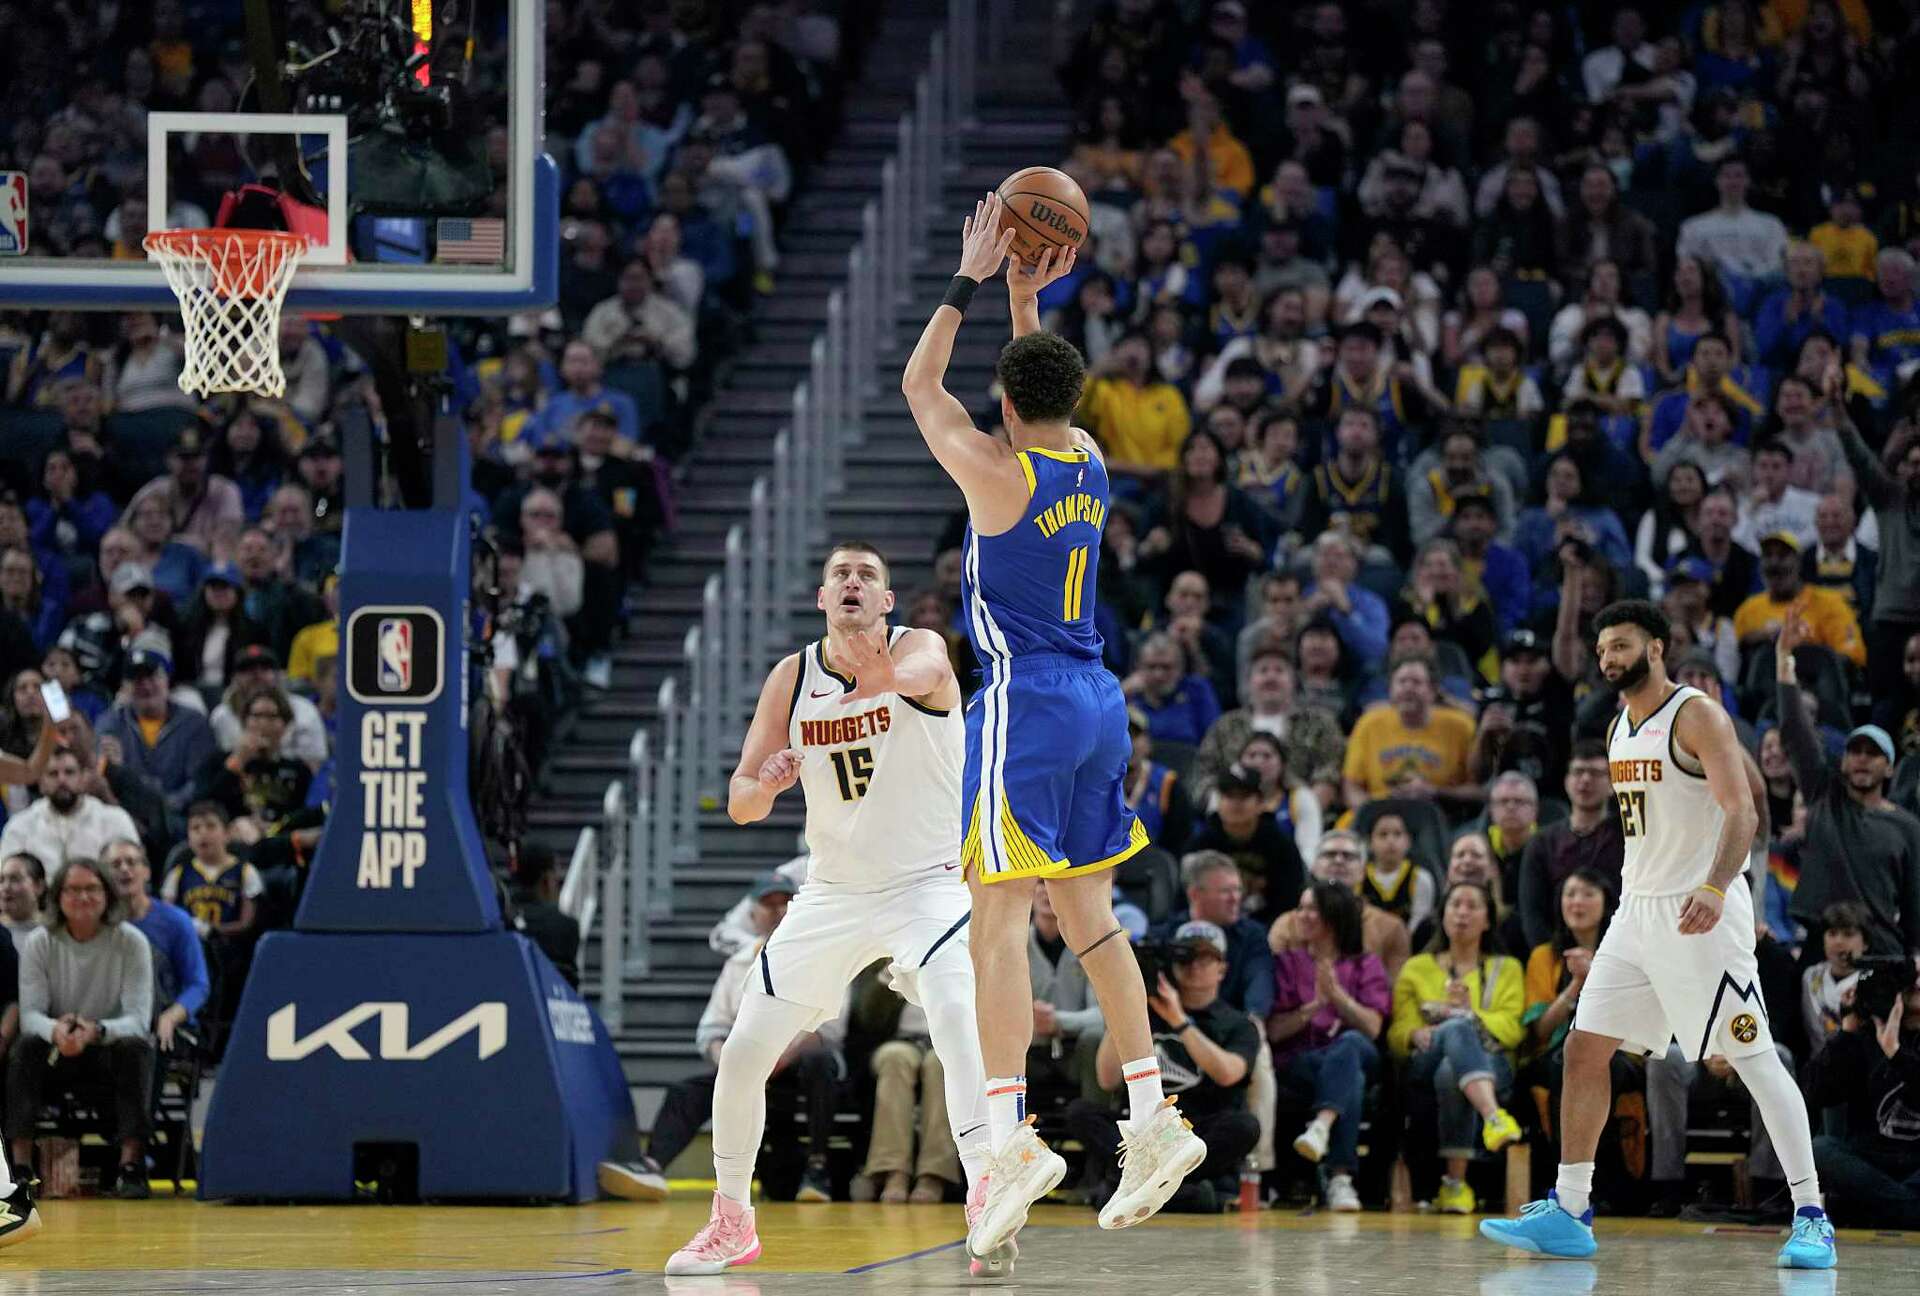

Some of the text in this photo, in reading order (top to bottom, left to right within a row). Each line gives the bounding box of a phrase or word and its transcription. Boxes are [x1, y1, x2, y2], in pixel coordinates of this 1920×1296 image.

[1030, 201, 1082, 242] Wilson
[1063, 545, 1088, 622] 11
[360, 710, 428, 769] GET
[800, 706, 892, 747] NUGGETS
[359, 771, 428, 829] THE
[829, 746, 876, 801] 15
[1618, 789, 1646, 837] 27
[356, 831, 427, 889] APP
